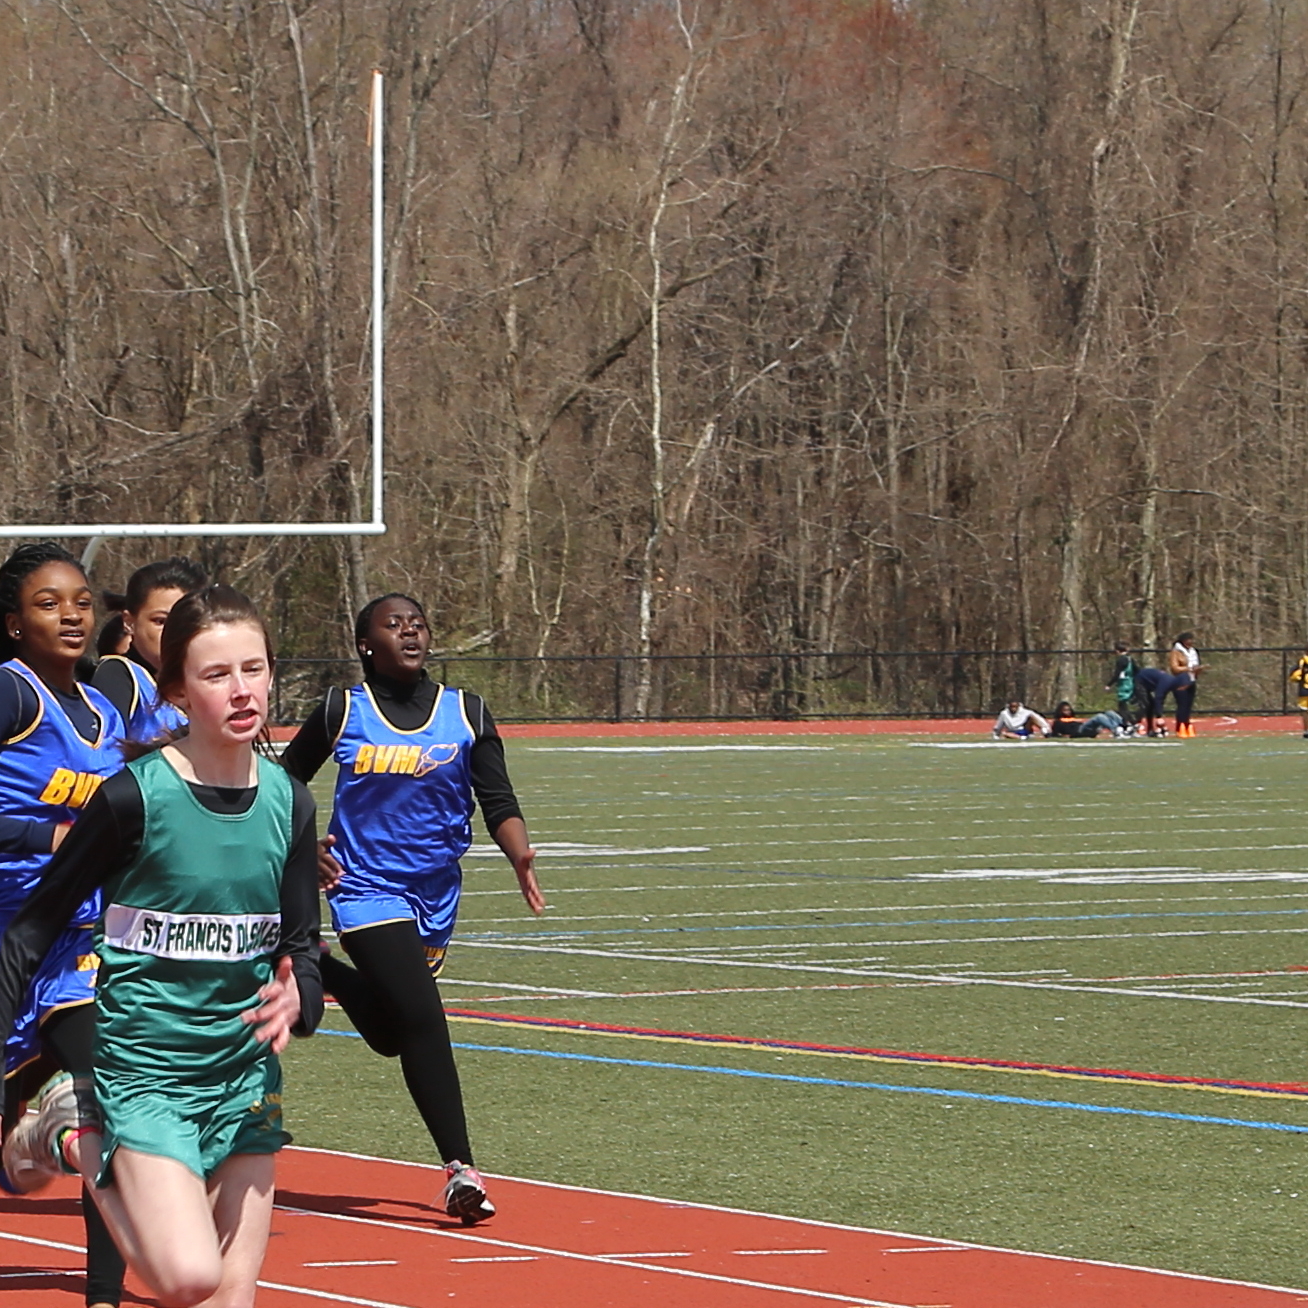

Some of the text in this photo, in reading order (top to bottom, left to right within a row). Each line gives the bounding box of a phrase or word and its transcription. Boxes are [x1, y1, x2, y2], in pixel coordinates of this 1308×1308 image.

[354, 744, 422, 774] BVM
[143, 917, 163, 949] ST.
[166, 921, 232, 953] FRANCIS
